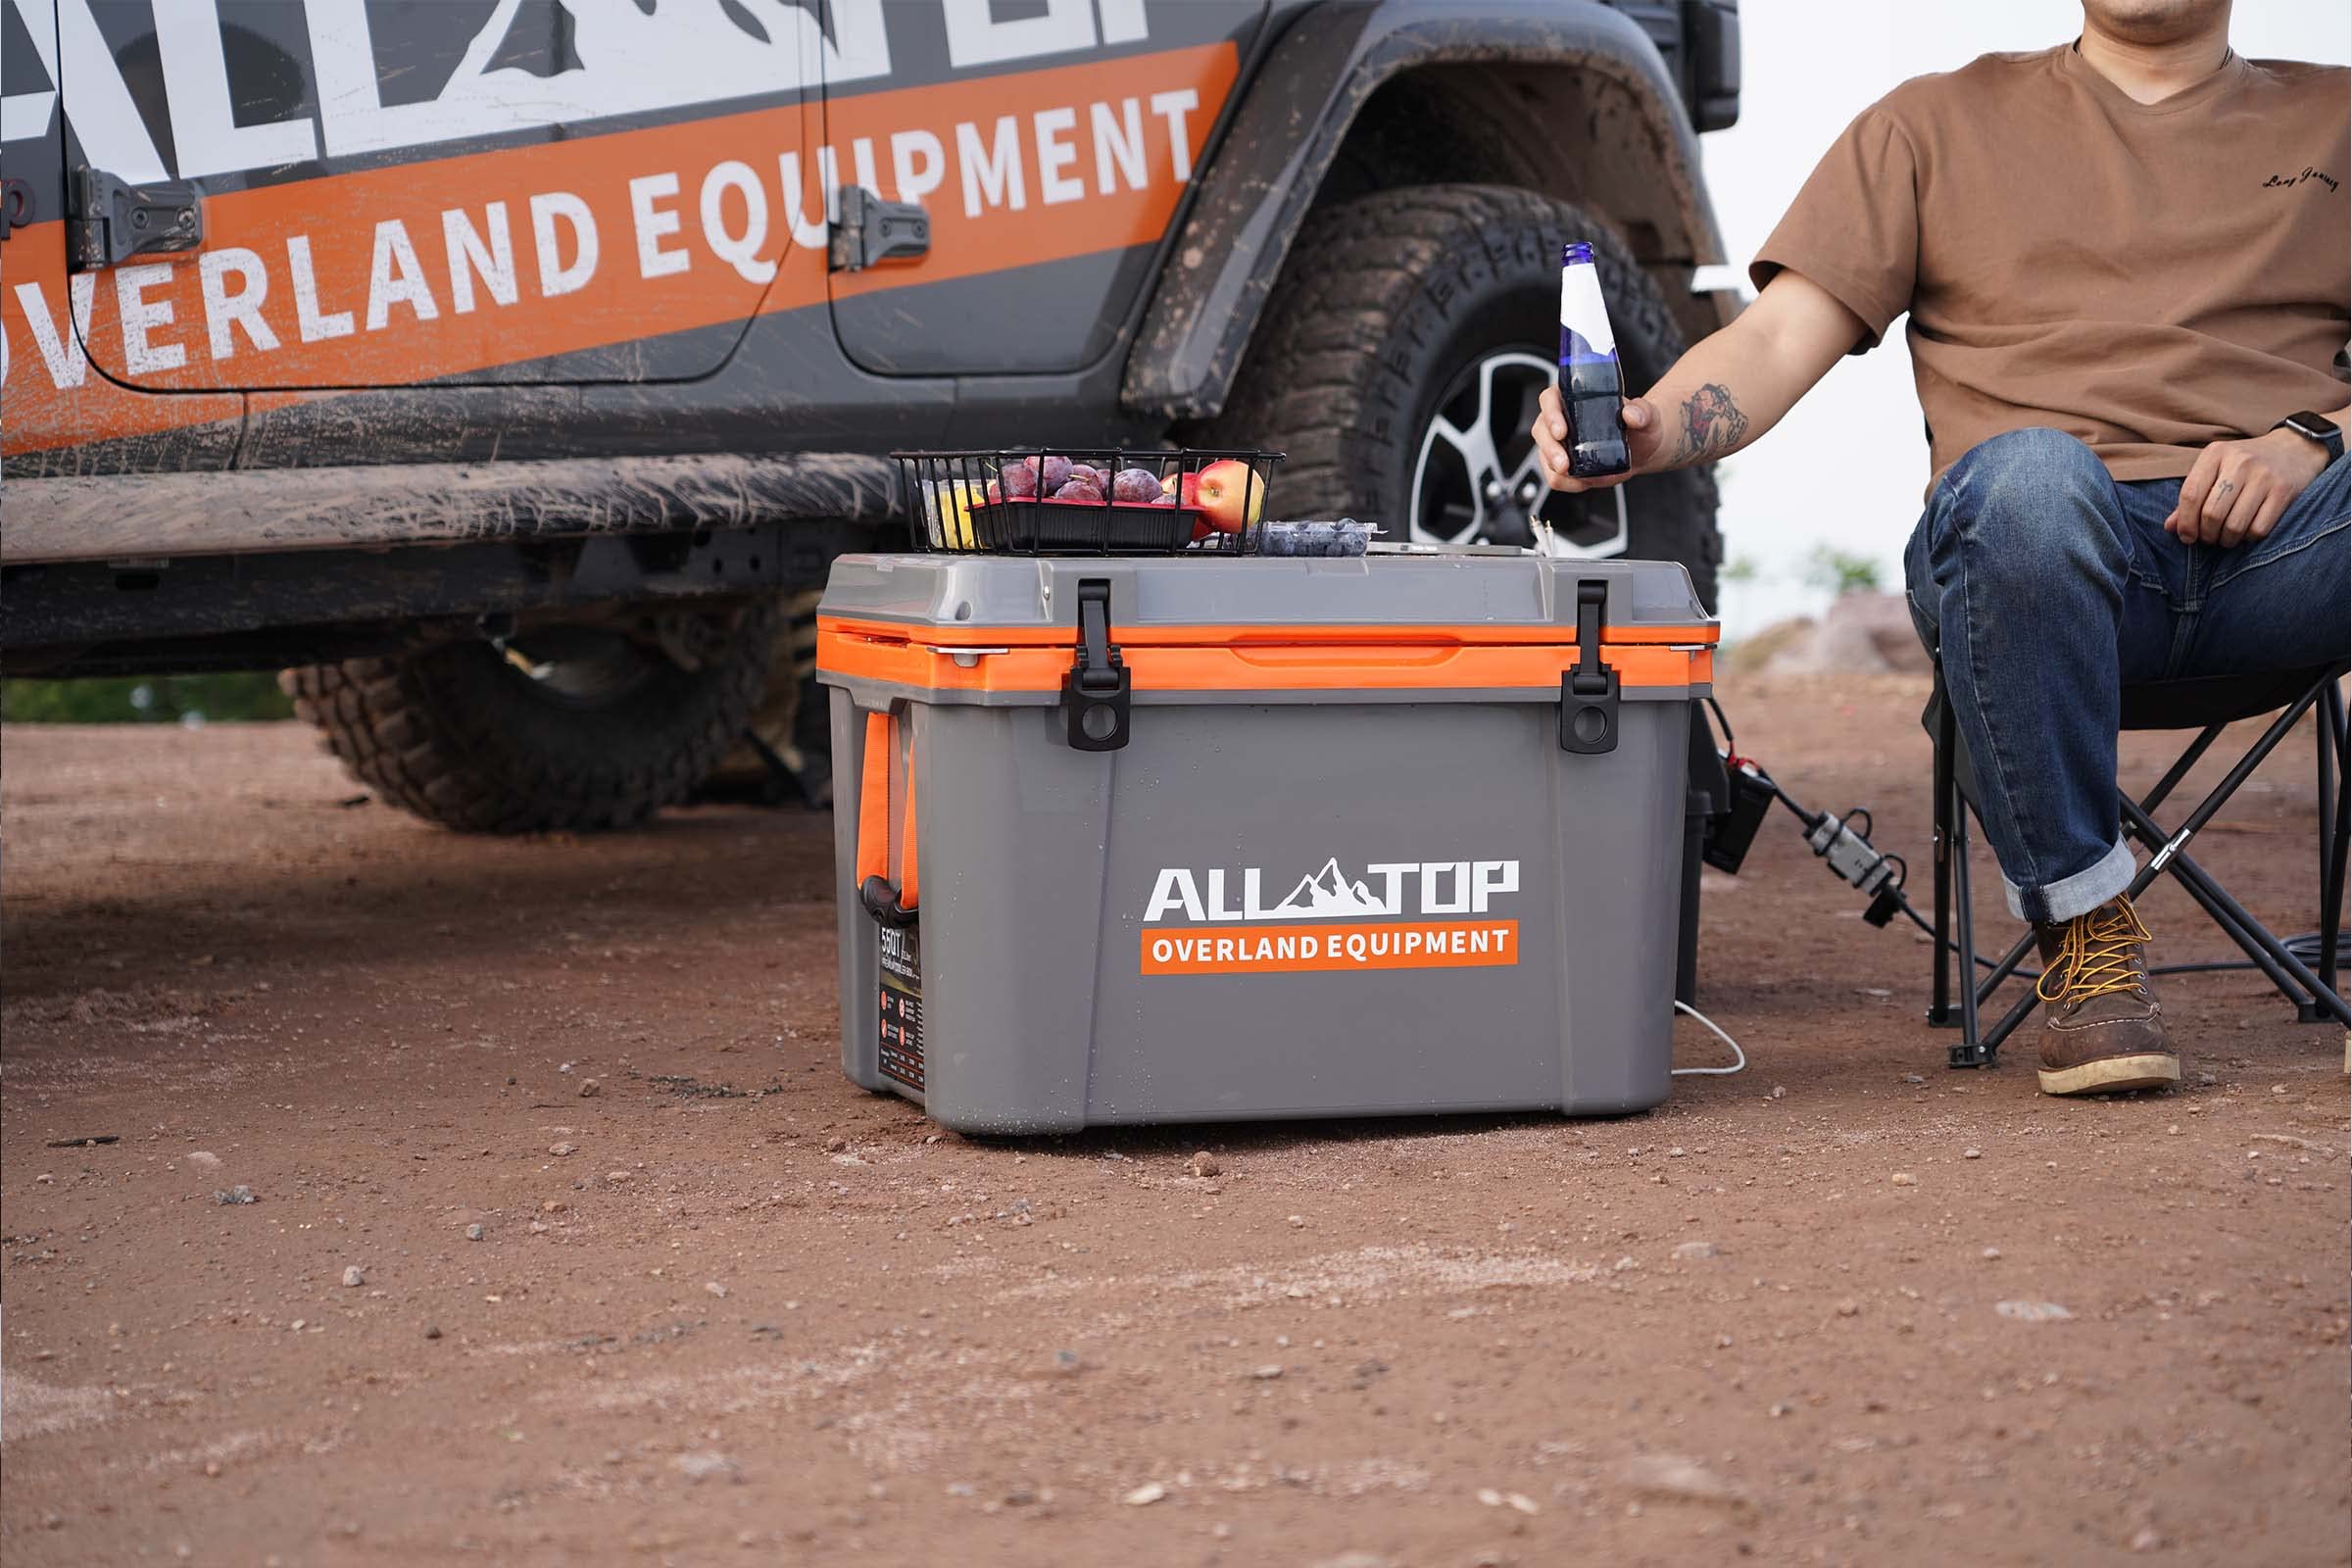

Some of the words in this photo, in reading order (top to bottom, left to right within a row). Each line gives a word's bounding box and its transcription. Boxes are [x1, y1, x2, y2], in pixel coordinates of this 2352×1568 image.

[1, 192, 598, 389] VERLAND
[629, 88, 1199, 284] EQUIPMENT
[881, 927, 902, 958] 55QT
[1152, 935, 1319, 962] OVERLAND
[1327, 928, 1510, 962] EQUIPMENT
